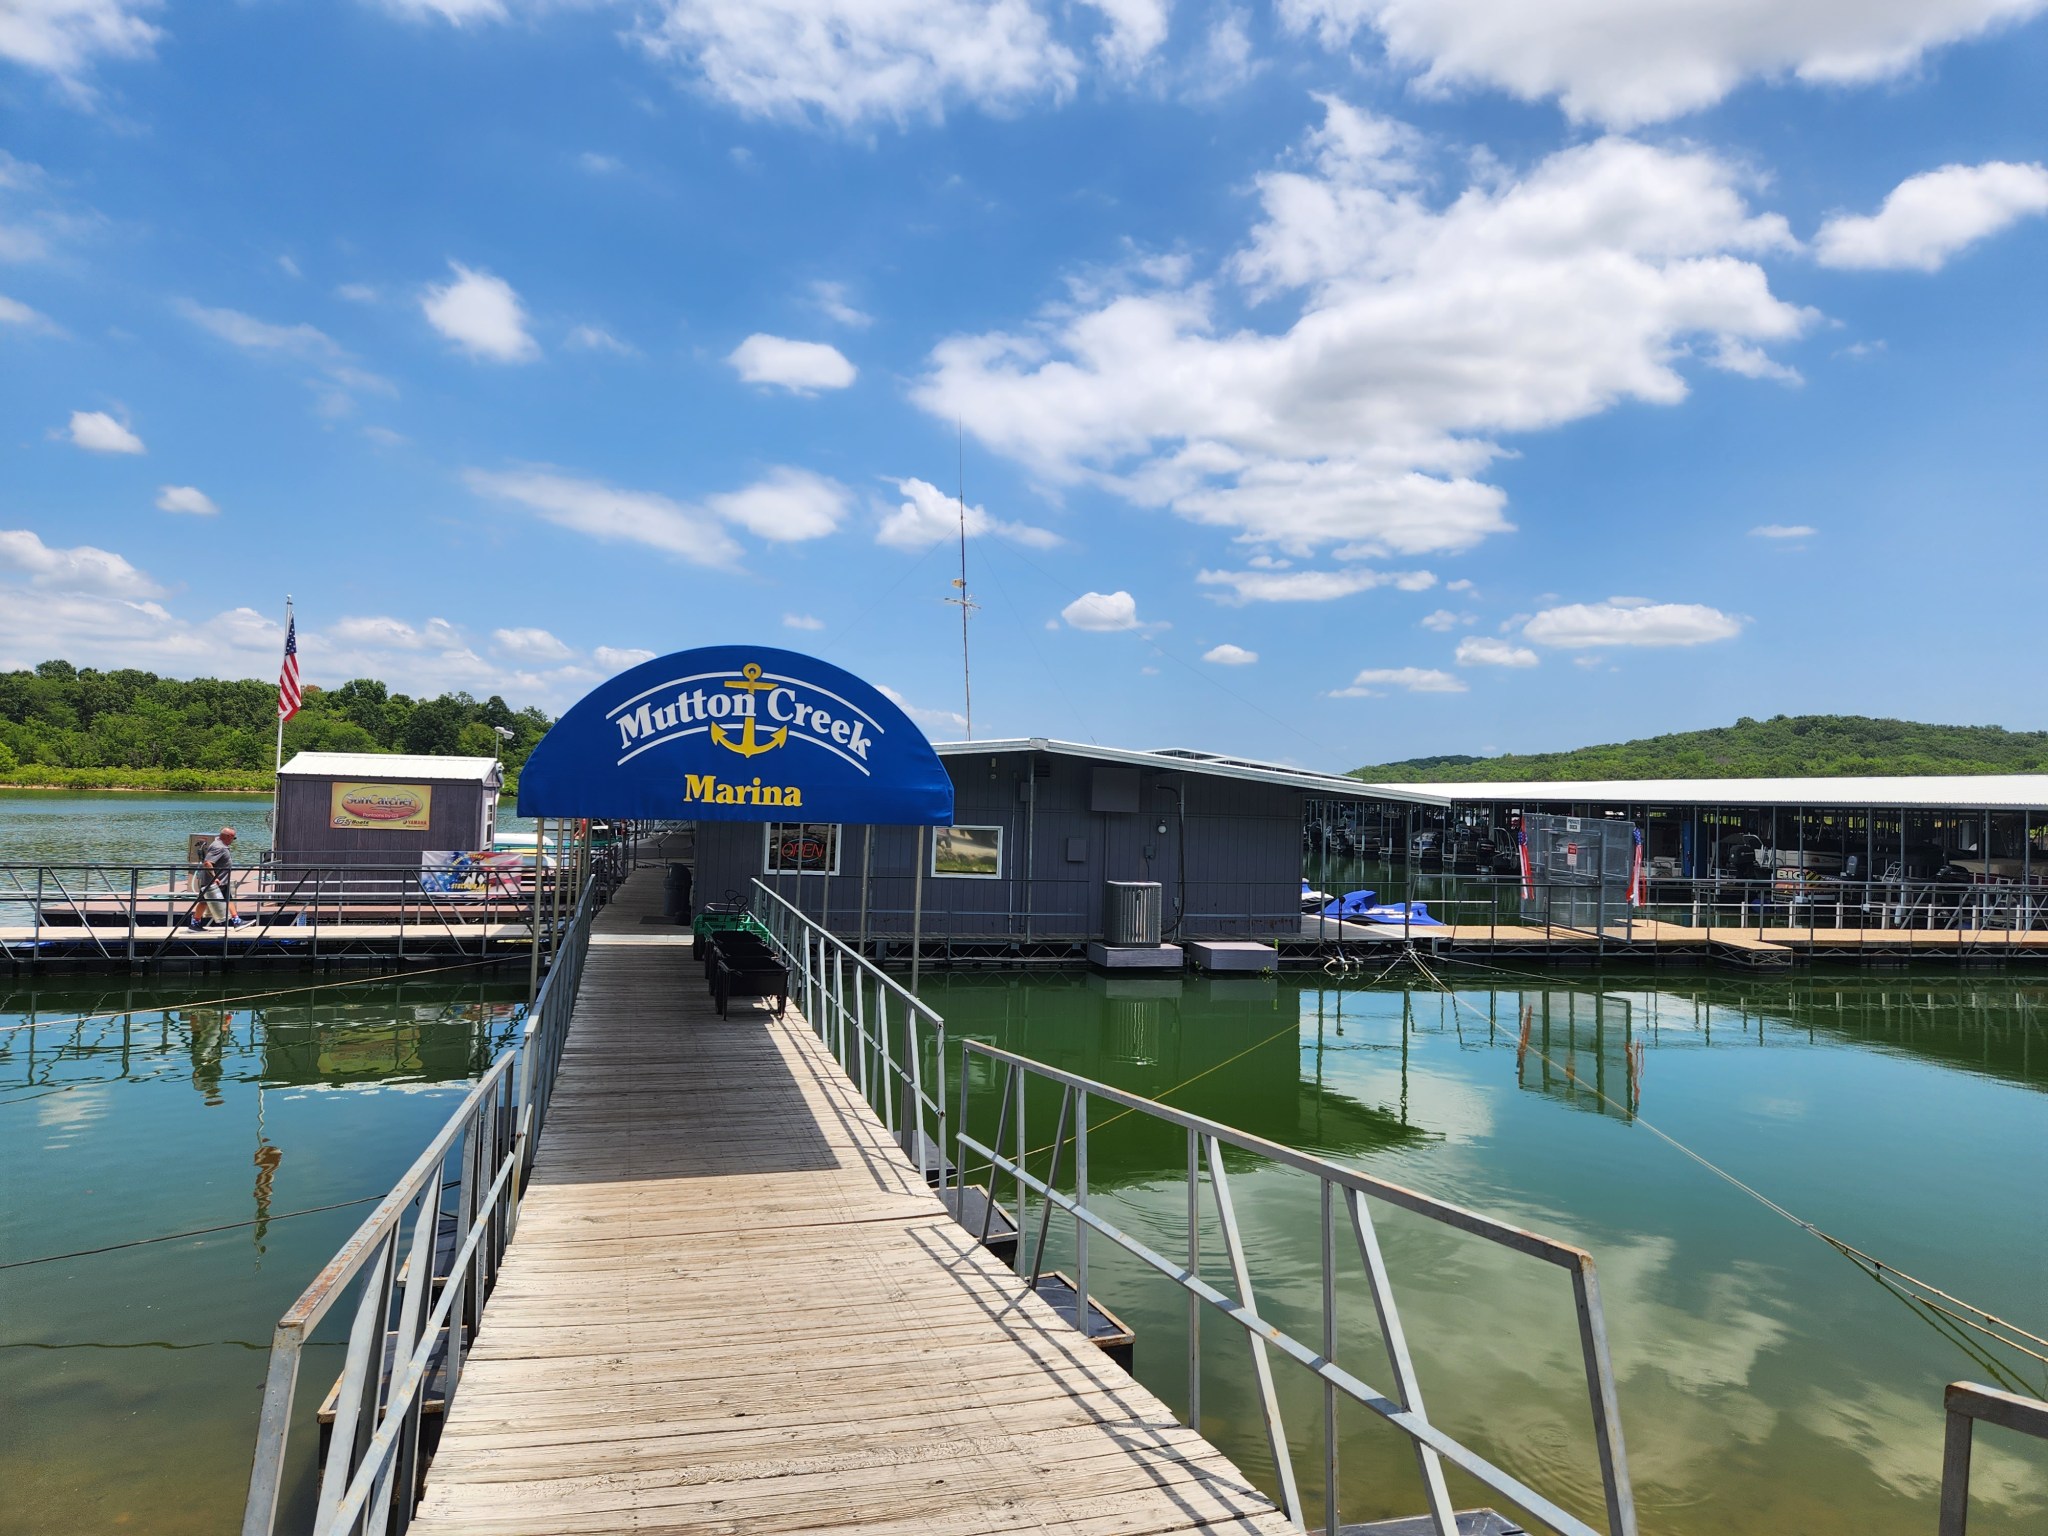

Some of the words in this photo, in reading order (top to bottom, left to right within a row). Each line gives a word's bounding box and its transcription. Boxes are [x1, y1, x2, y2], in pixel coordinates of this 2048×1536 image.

[616, 688, 757, 749] Mutton
[767, 688, 872, 760] Creek
[346, 793, 413, 806] SunCatcher
[683, 773, 803, 808] Marina
[782, 843, 824, 858] OPEN
